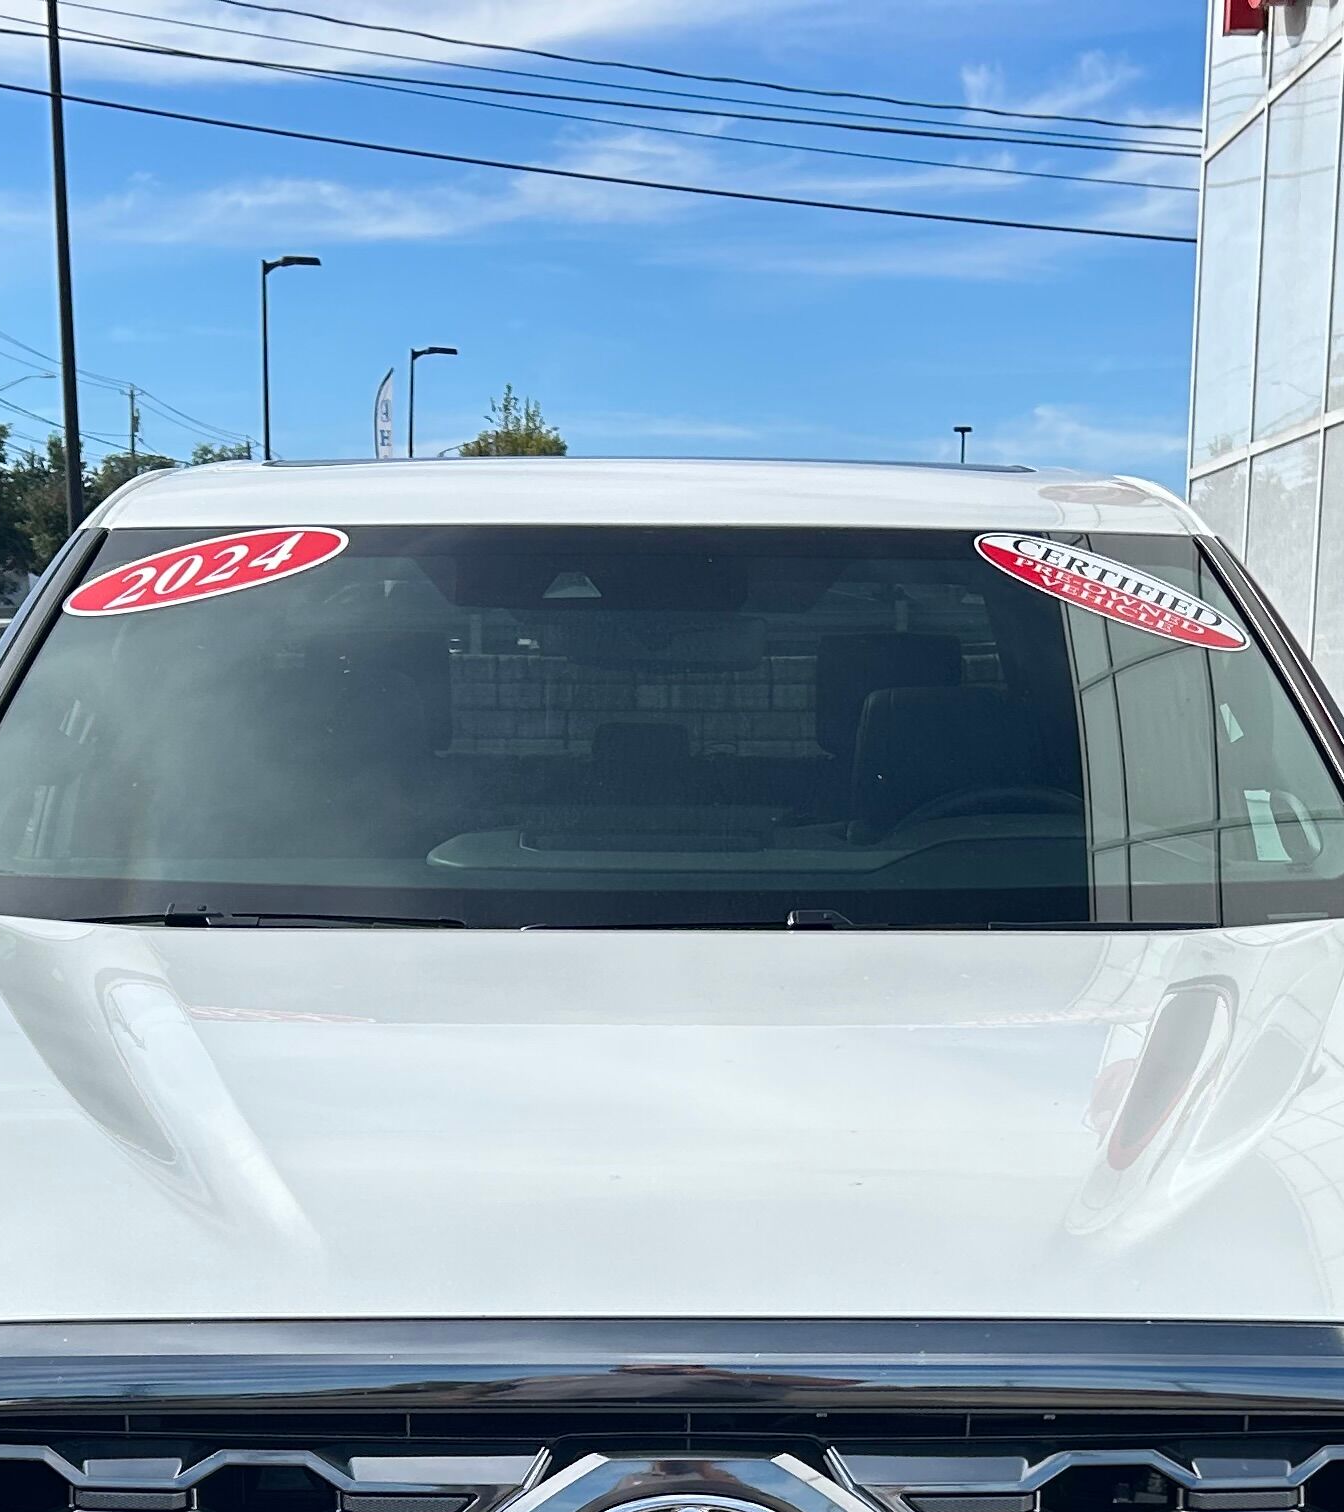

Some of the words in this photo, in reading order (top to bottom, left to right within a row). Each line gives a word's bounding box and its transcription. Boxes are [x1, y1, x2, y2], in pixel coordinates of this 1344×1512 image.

[102, 531, 306, 610] 2024
[1013, 539, 1222, 627] CERTIFIED
[1013, 557, 1205, 635] PRE-OWNED
[1041, 575, 1173, 633] VEHICLE
